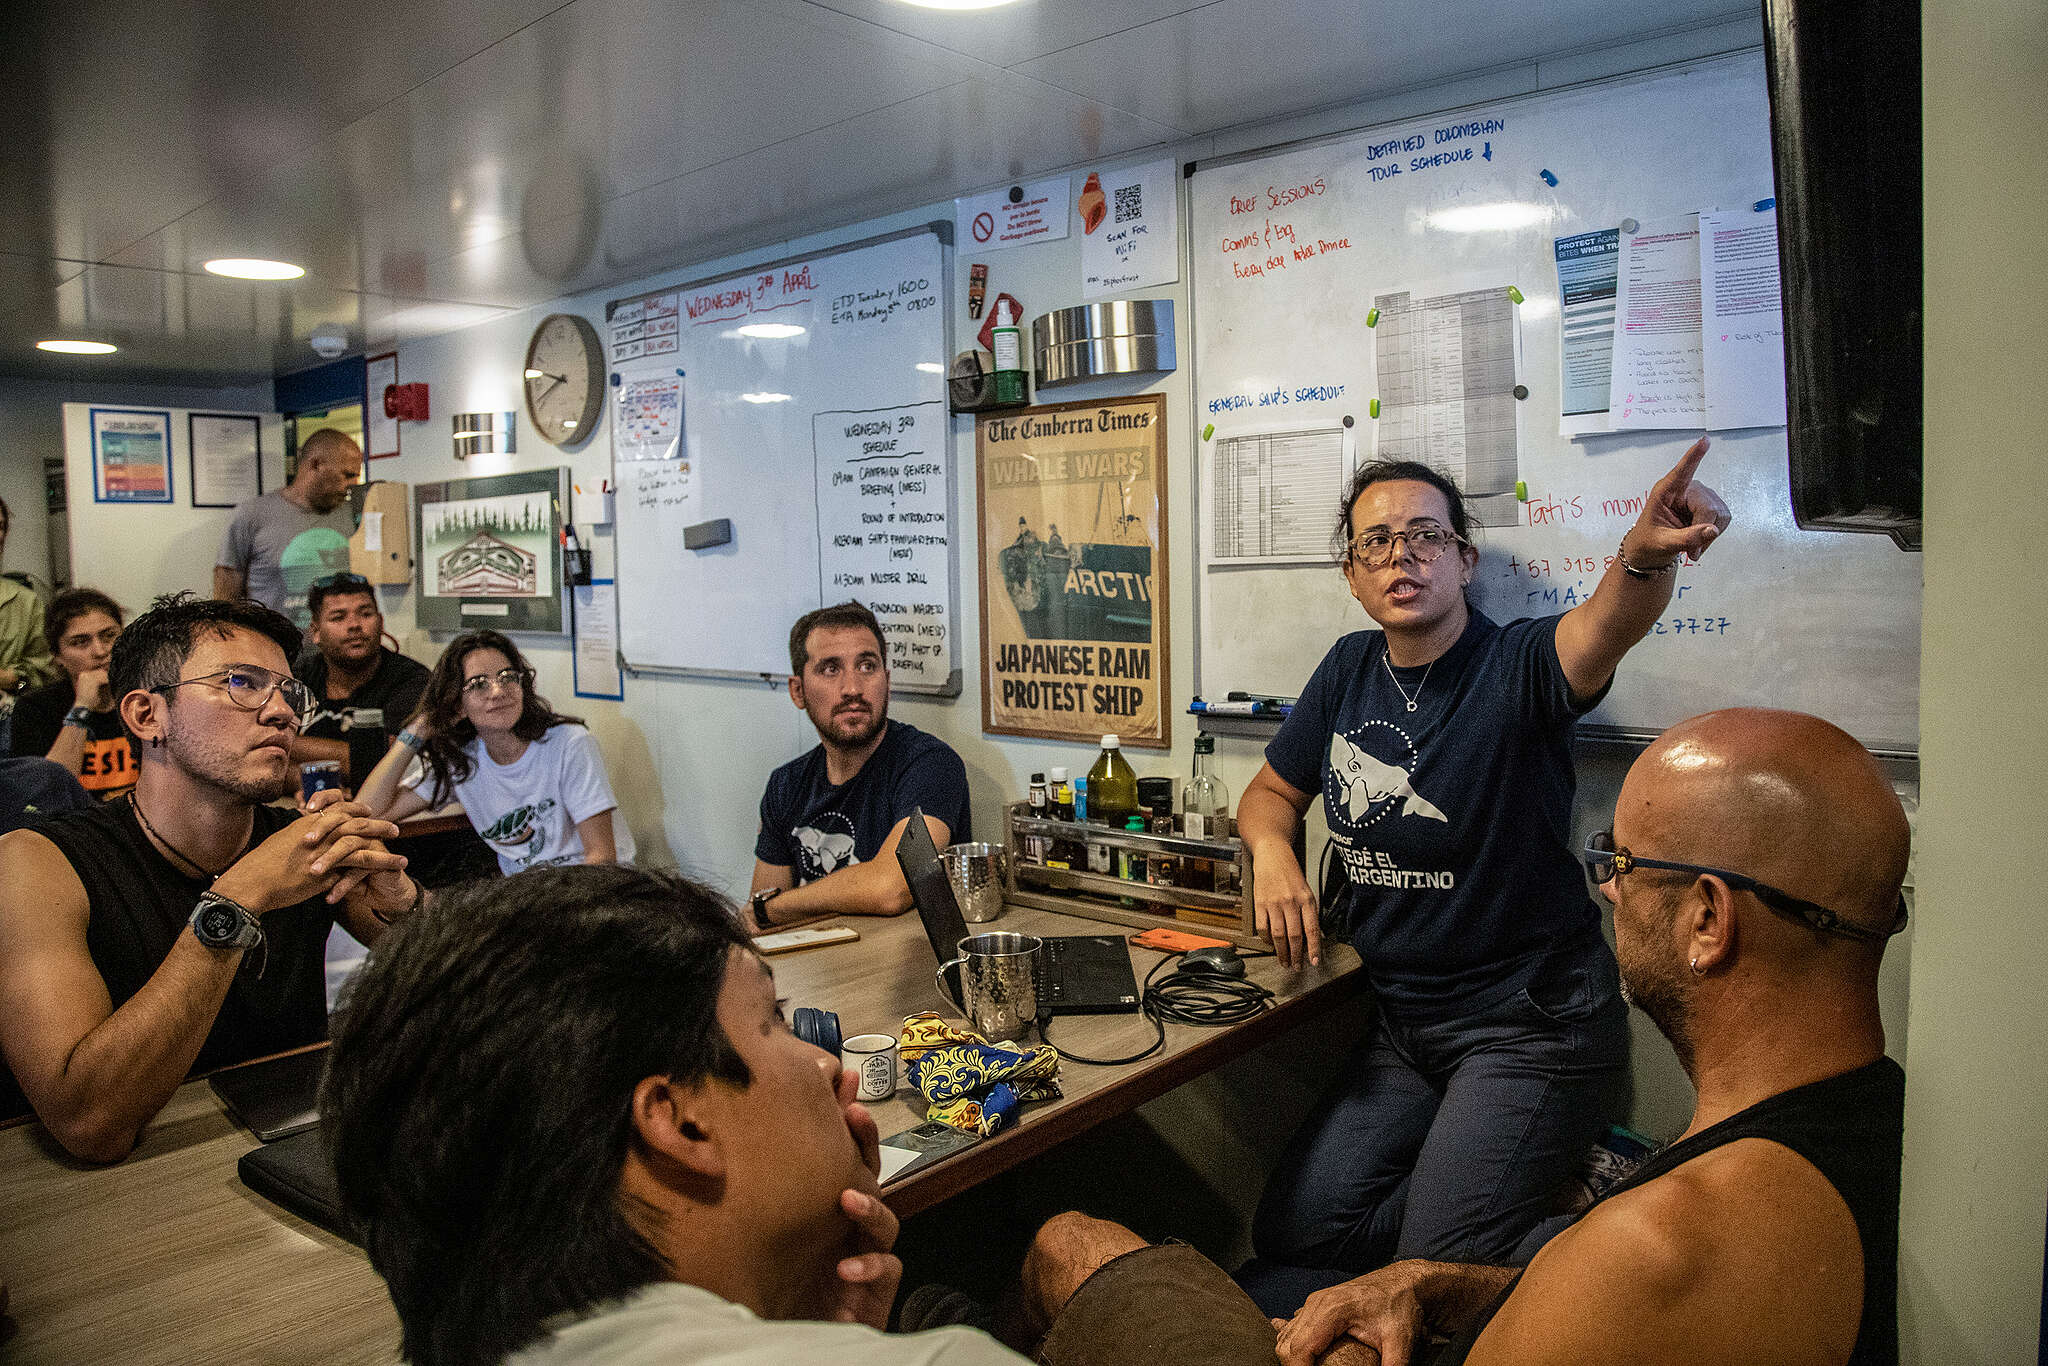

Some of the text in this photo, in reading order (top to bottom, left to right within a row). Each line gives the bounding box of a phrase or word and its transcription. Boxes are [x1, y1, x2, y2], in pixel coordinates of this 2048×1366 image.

[1367, 119, 1505, 161] DETAILED COLOMBIAN
[1367, 147, 1473, 183] TOUR SCHEDULE
[1132, 225, 1148, 235] FOR
[1558, 238, 1595, 251] PROTECT
[1558, 249, 1579, 259] BITES
[1580, 244, 1605, 255] WHEN
[898, 279, 928, 296] 1600
[908, 296, 936, 311] 0800
[1208, 395, 1252, 415] GENERAL
[1295, 385, 1345, 402] SCHEDULE
[988, 409, 1149, 443] The Canberra Times
[993, 449, 1146, 484] WHALE WARS
[1563, 557, 1596, 573] 315
[871, 572, 901, 584] MUSTER
[996, 644, 1151, 680] JAPANESE RAM
[1003, 680, 1143, 717] PROTEST SHIP
[1375, 851, 1398, 869] EL
[1350, 866, 1454, 889] ARGENTINO
